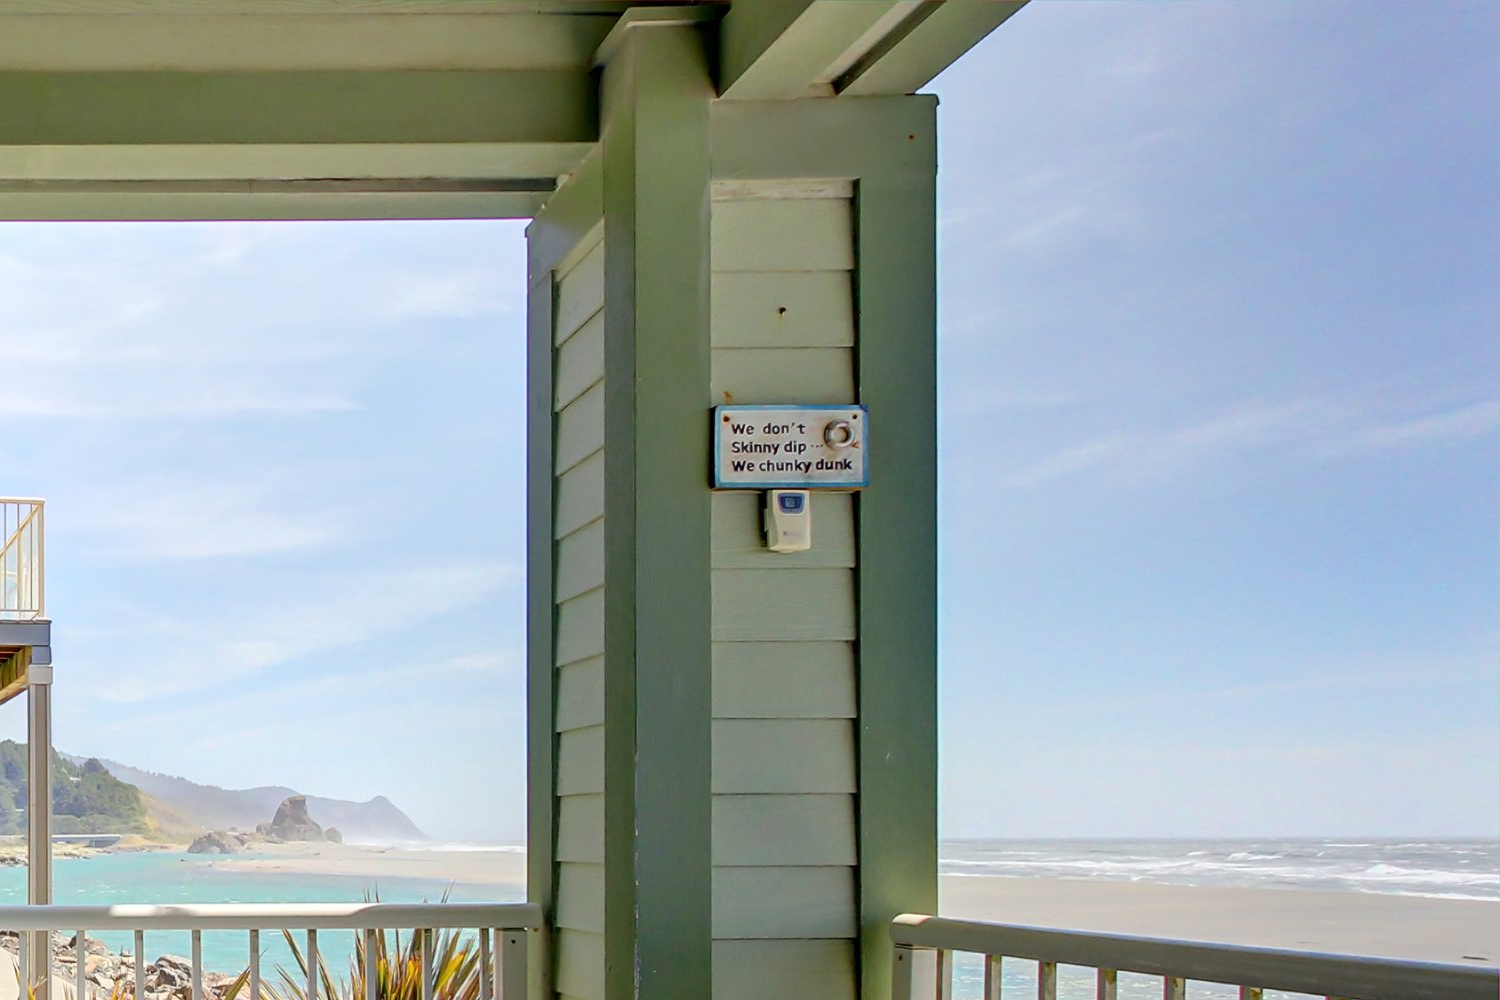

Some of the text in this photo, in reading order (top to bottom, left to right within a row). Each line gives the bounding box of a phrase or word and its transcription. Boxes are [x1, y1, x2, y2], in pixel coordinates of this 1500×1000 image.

[731, 423, 806, 434] We don't
[731, 442, 780, 454] Skinny
[731, 459, 852, 473] We chunky dunk
